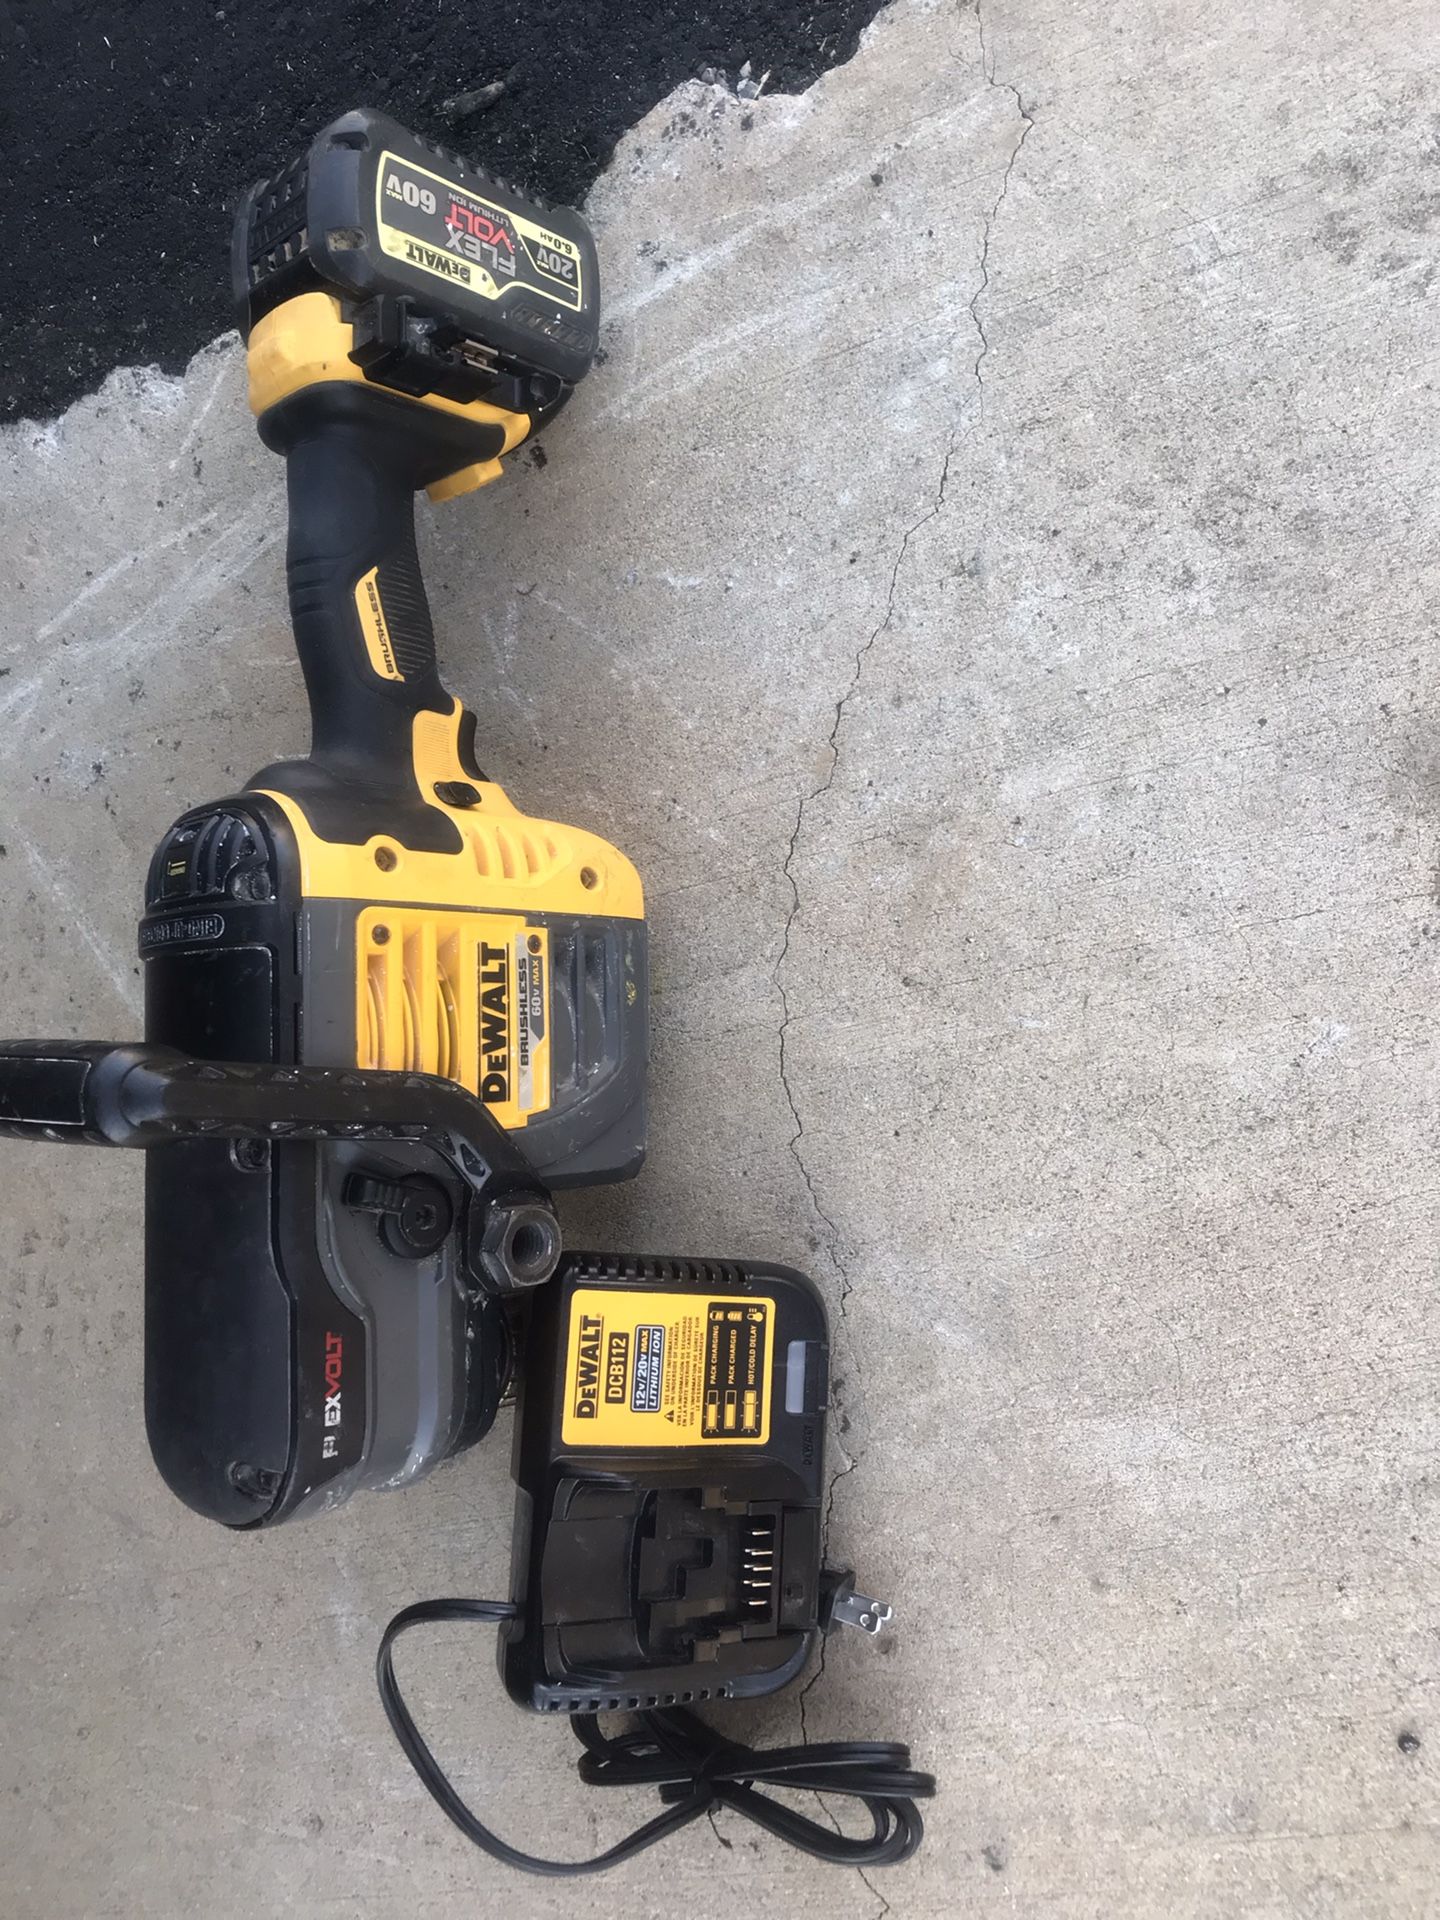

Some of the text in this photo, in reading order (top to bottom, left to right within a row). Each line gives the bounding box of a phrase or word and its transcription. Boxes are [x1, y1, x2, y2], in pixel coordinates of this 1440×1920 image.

[386, 174, 436, 215] 60V
[448, 192, 509, 227] LITHIUM ION
[444, 203, 515, 255] VOLT
[445, 223, 516, 278] FLEX
[405, 242, 471, 284] DEWALT
[536, 246, 573, 279] 20V
[366, 581, 394, 673] BRUSHLESS
[532, 959, 540, 985] MAX
[480, 941, 507, 1103] DEWALT
[518, 957, 529, 1066] BRUSHLESS
[640, 1330, 649, 1353] MAX
[680, 1352, 685, 1360] DE
[710, 1325, 719, 1385] PACK CHARGING
[729, 1329, 737, 1364] CHARGED
[748, 1325, 758, 1385] HOT/COLD DELAY
[576, 1315, 601, 1418] DEWALT
[608, 1338, 626, 1398] DCB112
[649, 1330, 661, 1407] LITHIUM ION
[670, 1396, 675, 1405] ON
[682, 1419, 687, 1427] EN
